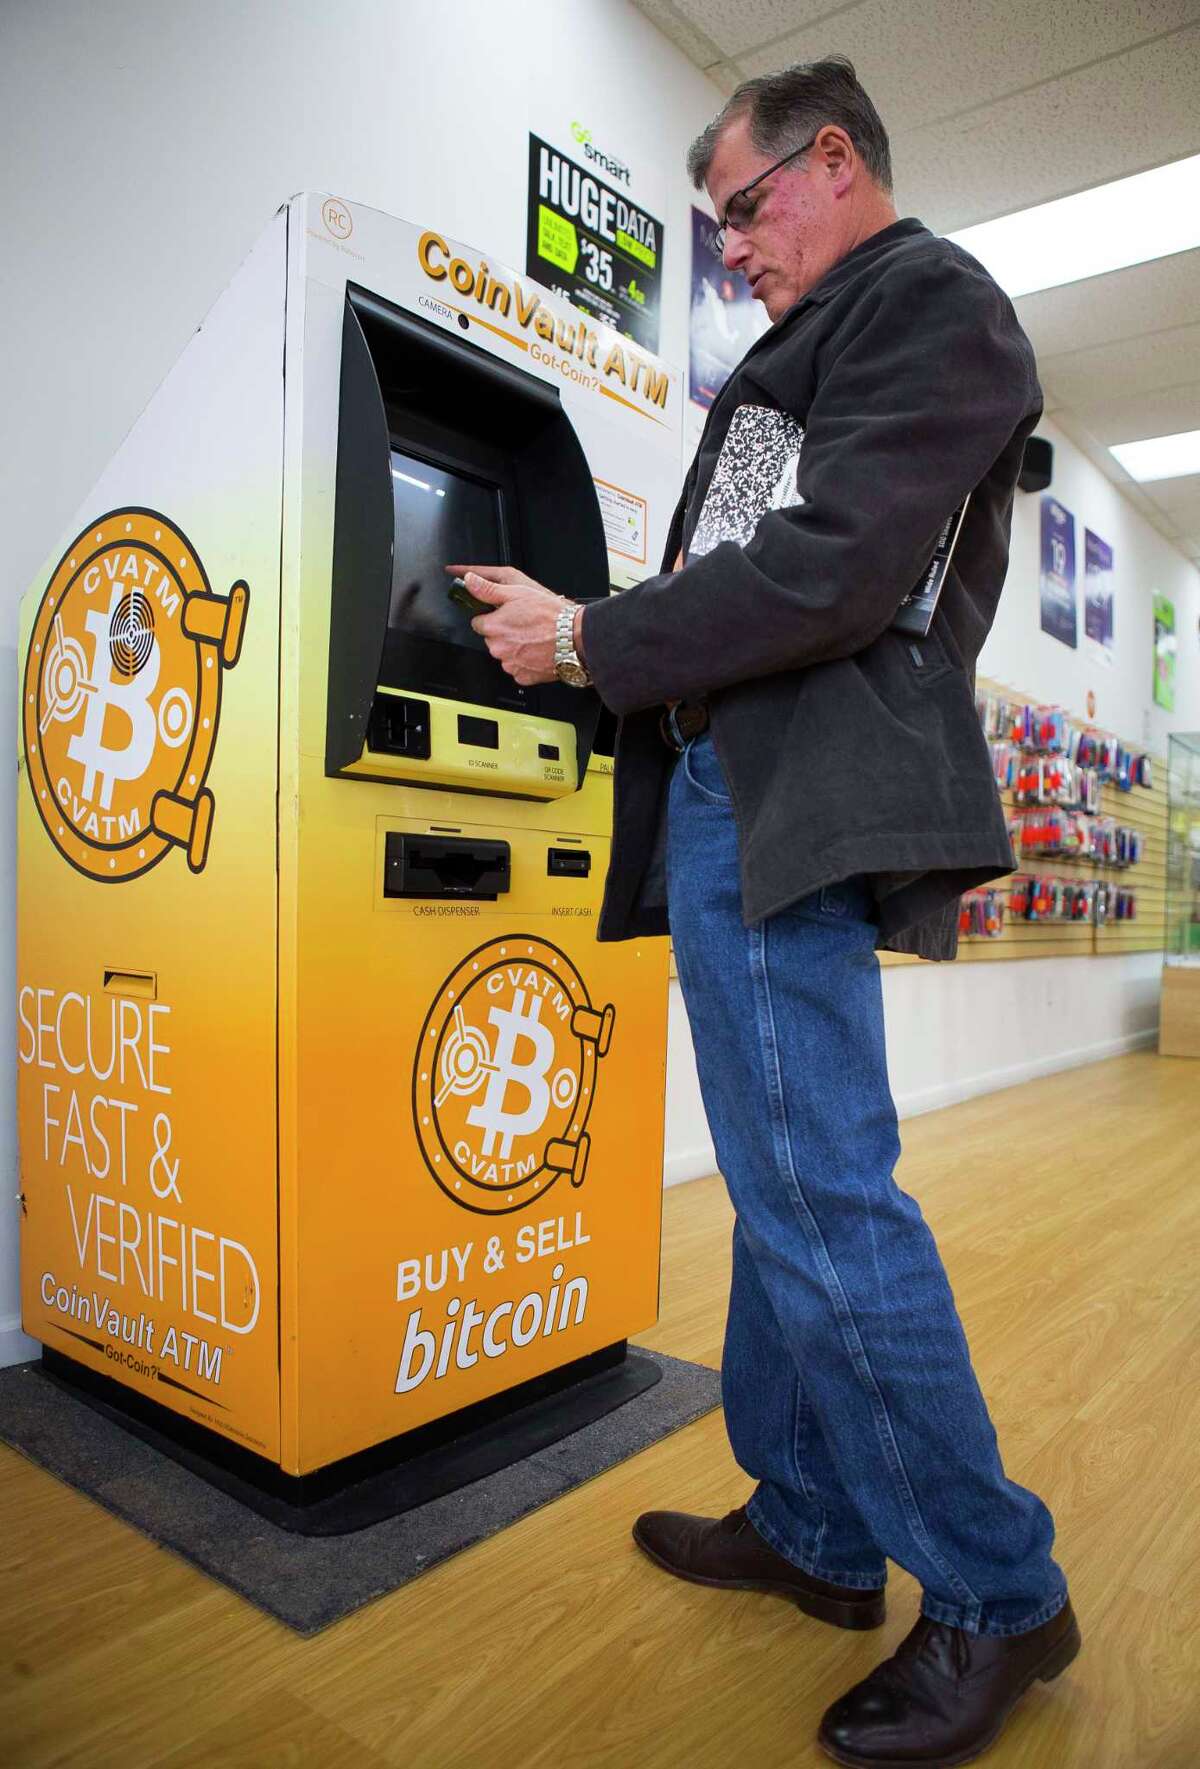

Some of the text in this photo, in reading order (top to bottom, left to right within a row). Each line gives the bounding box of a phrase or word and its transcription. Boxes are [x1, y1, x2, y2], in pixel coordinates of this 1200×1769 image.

[584, 143, 631, 187] smart
[539, 146, 617, 243] HUGE
[616, 198, 657, 253] DATA
[417, 230, 600, 369] CoinVault
[602, 343, 671, 410] ATM
[418, 295, 453, 320] CAMERA
[529, 342, 600, 393] Got-Coin?
[83, 553, 181, 619] CVATM
[475, 760, 499, 770] SCANNER
[57, 776, 141, 840] CVATM
[412, 906, 481, 917] CASH DISPENSER
[551, 907, 593, 917] INSERT CASH
[486, 967, 572, 1022] CVATM
[18, 984, 173, 1096] SECURE
[43, 1082, 183, 1204] FAST &
[453, 1140, 537, 1183] CVATM
[66, 1184, 261, 1335] VERIFIED
[396, 1211, 592, 1302] BUY & SELL
[40, 1271, 224, 1386] CoinVault ATM
[393, 1262, 590, 1395] bitcoin
[104, 1342, 160, 1382] Got-Coin?
